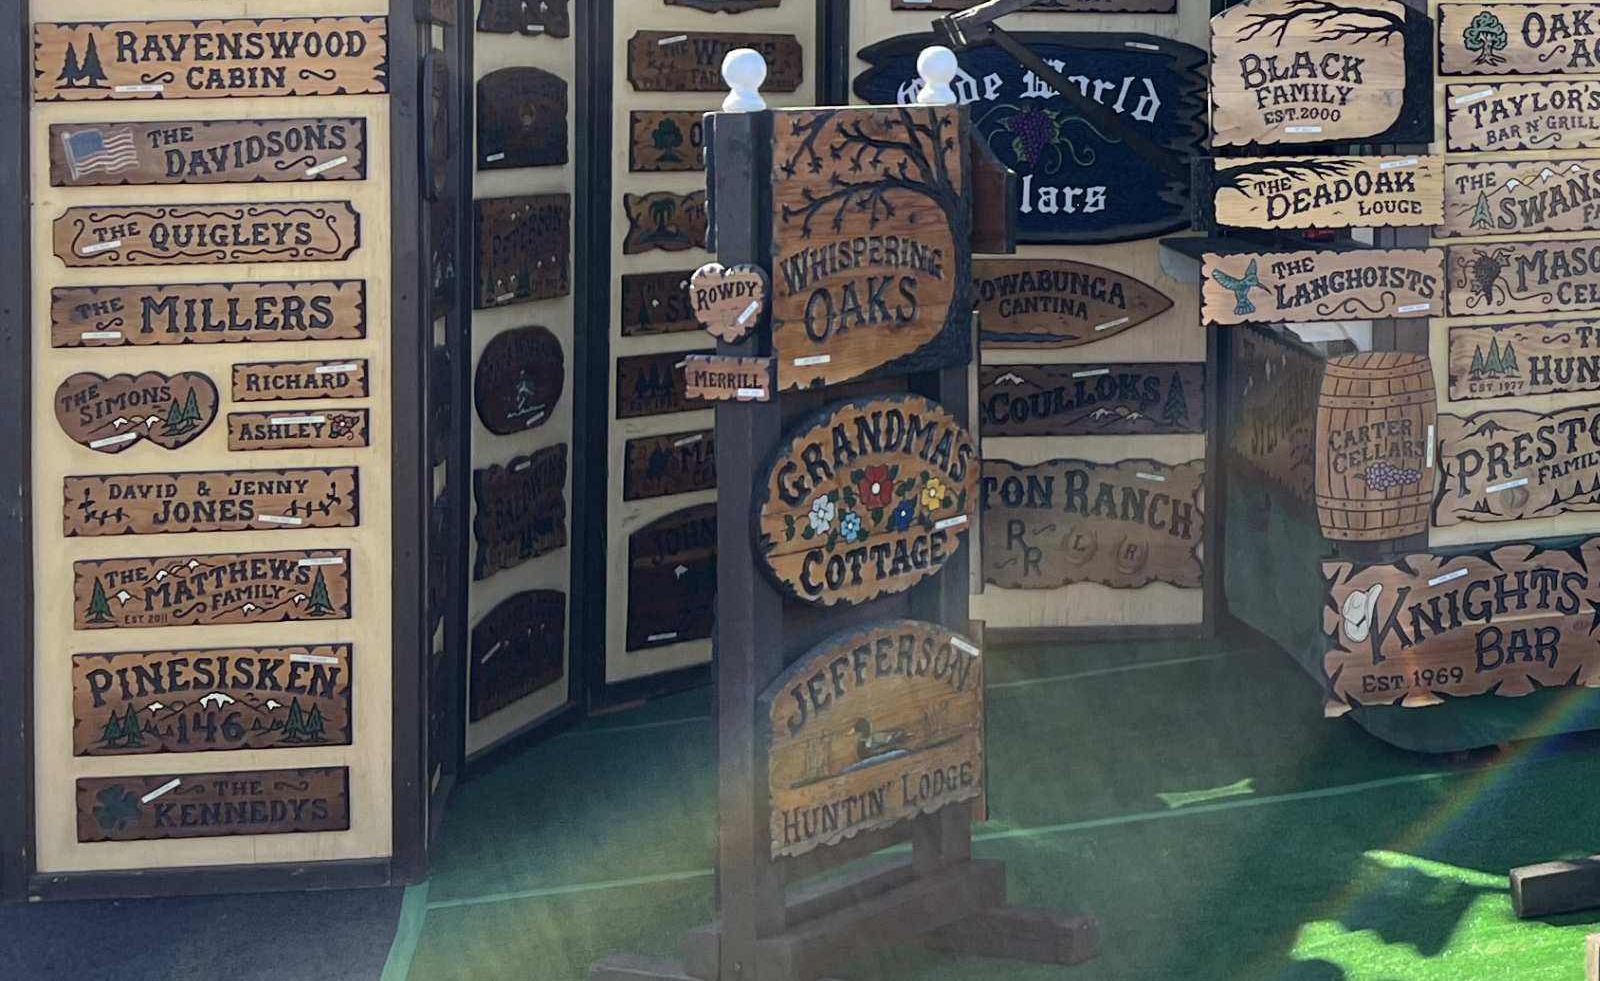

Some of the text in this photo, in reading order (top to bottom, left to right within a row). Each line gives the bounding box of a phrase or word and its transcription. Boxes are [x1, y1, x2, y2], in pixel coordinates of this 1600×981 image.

[1522, 9, 1594, 48] OAK
[116, 30, 367, 66] RAVENSWOOD
[186, 66, 287, 91] CABIN
[1239, 51, 1365, 90] BLACK
[1255, 83, 1354, 110] FAMILY
[1468, 85, 1600, 129] TAYLOR'S
[1486, 115, 1600, 146] BAR GRILL
[148, 122, 347, 177] THE DAVIDSONS
[1254, 177, 1292, 196] THE
[1456, 172, 1496, 194] THE
[1358, 200, 1422, 216] LOUGE
[93, 222, 312, 251] THE QUIGLEYS
[780, 235, 945, 297] WHISPERING
[1272, 257, 1314, 279] THE
[696, 281, 758, 311] ROWDY
[1274, 266, 1436, 310] LANGHOISTS
[75, 296, 334, 333] THE MILLERS
[805, 275, 918, 344] OAKS
[1000, 296, 1088, 320] CANTINA
[245, 372, 350, 392] RICHARD
[694, 370, 763, 389] MERRILL
[80, 386, 171, 427] SIMONS
[239, 421, 324, 441] ASHLEY
[1329, 419, 1412, 451] CARTER
[777, 408, 974, 506] GRANDMA'S
[1333, 438, 1424, 474] CELLARS
[108, 480, 309, 500] DAVID JENNY
[1064, 469, 1192, 538] RANCH
[153, 500, 255, 524] JONES
[799, 530, 948, 596] COTTAGE
[104, 558, 311, 612] THE MATTHEWS
[211, 585, 285, 611] FAMILY
[1369, 569, 1588, 665] KNIGHTS
[1474, 626, 1561, 674] BAR
[85, 656, 341, 708] PINESISKEN
[787, 634, 975, 737] JEFFERSON
[1413, 668, 1464, 687] 1969
[177, 713, 247, 745] 146
[214, 781, 263, 796] THE
[781, 761, 974, 843] HUNTIN' LODGE
[154, 798, 328, 828] KENNEDYS
